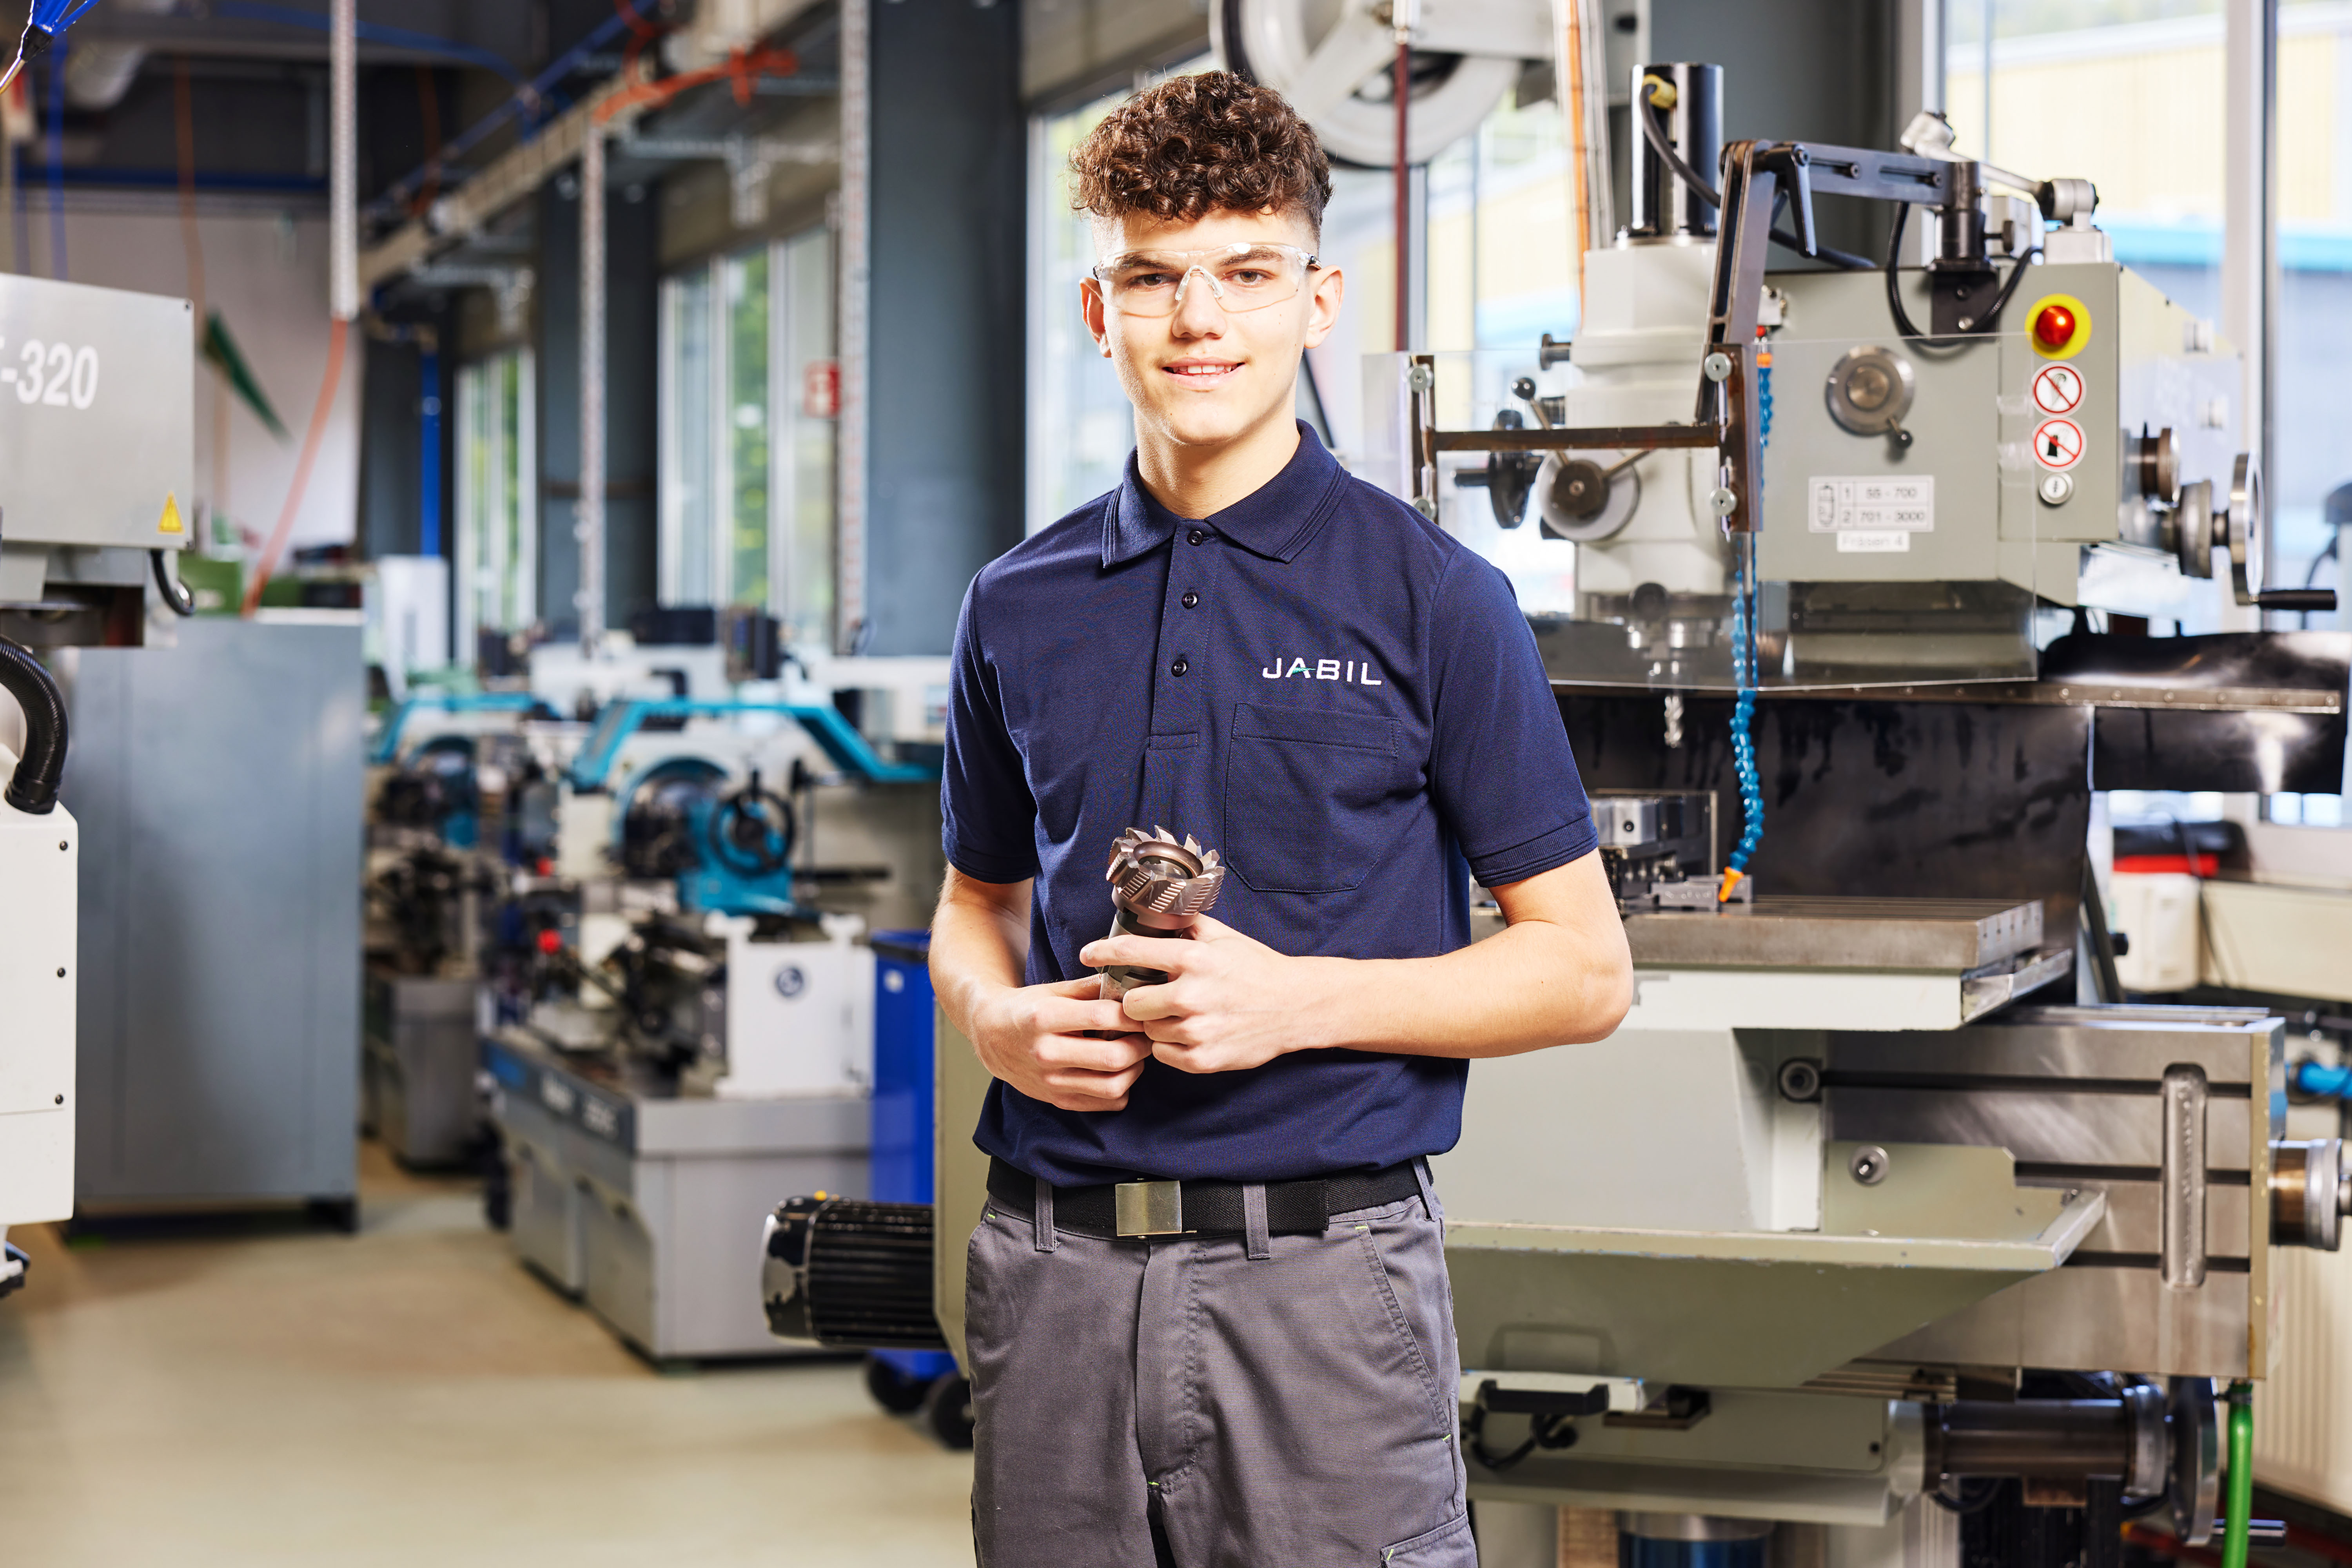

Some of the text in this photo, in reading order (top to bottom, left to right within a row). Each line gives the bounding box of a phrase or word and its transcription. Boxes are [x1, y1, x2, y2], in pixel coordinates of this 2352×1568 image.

[0, 336, 99, 410] -320
[1894, 486, 1918, 499] 700
[1843, 510, 1851, 523] 2
[1860, 510, 1881, 523] 701
[1262, 657, 1382, 685] JABIL
